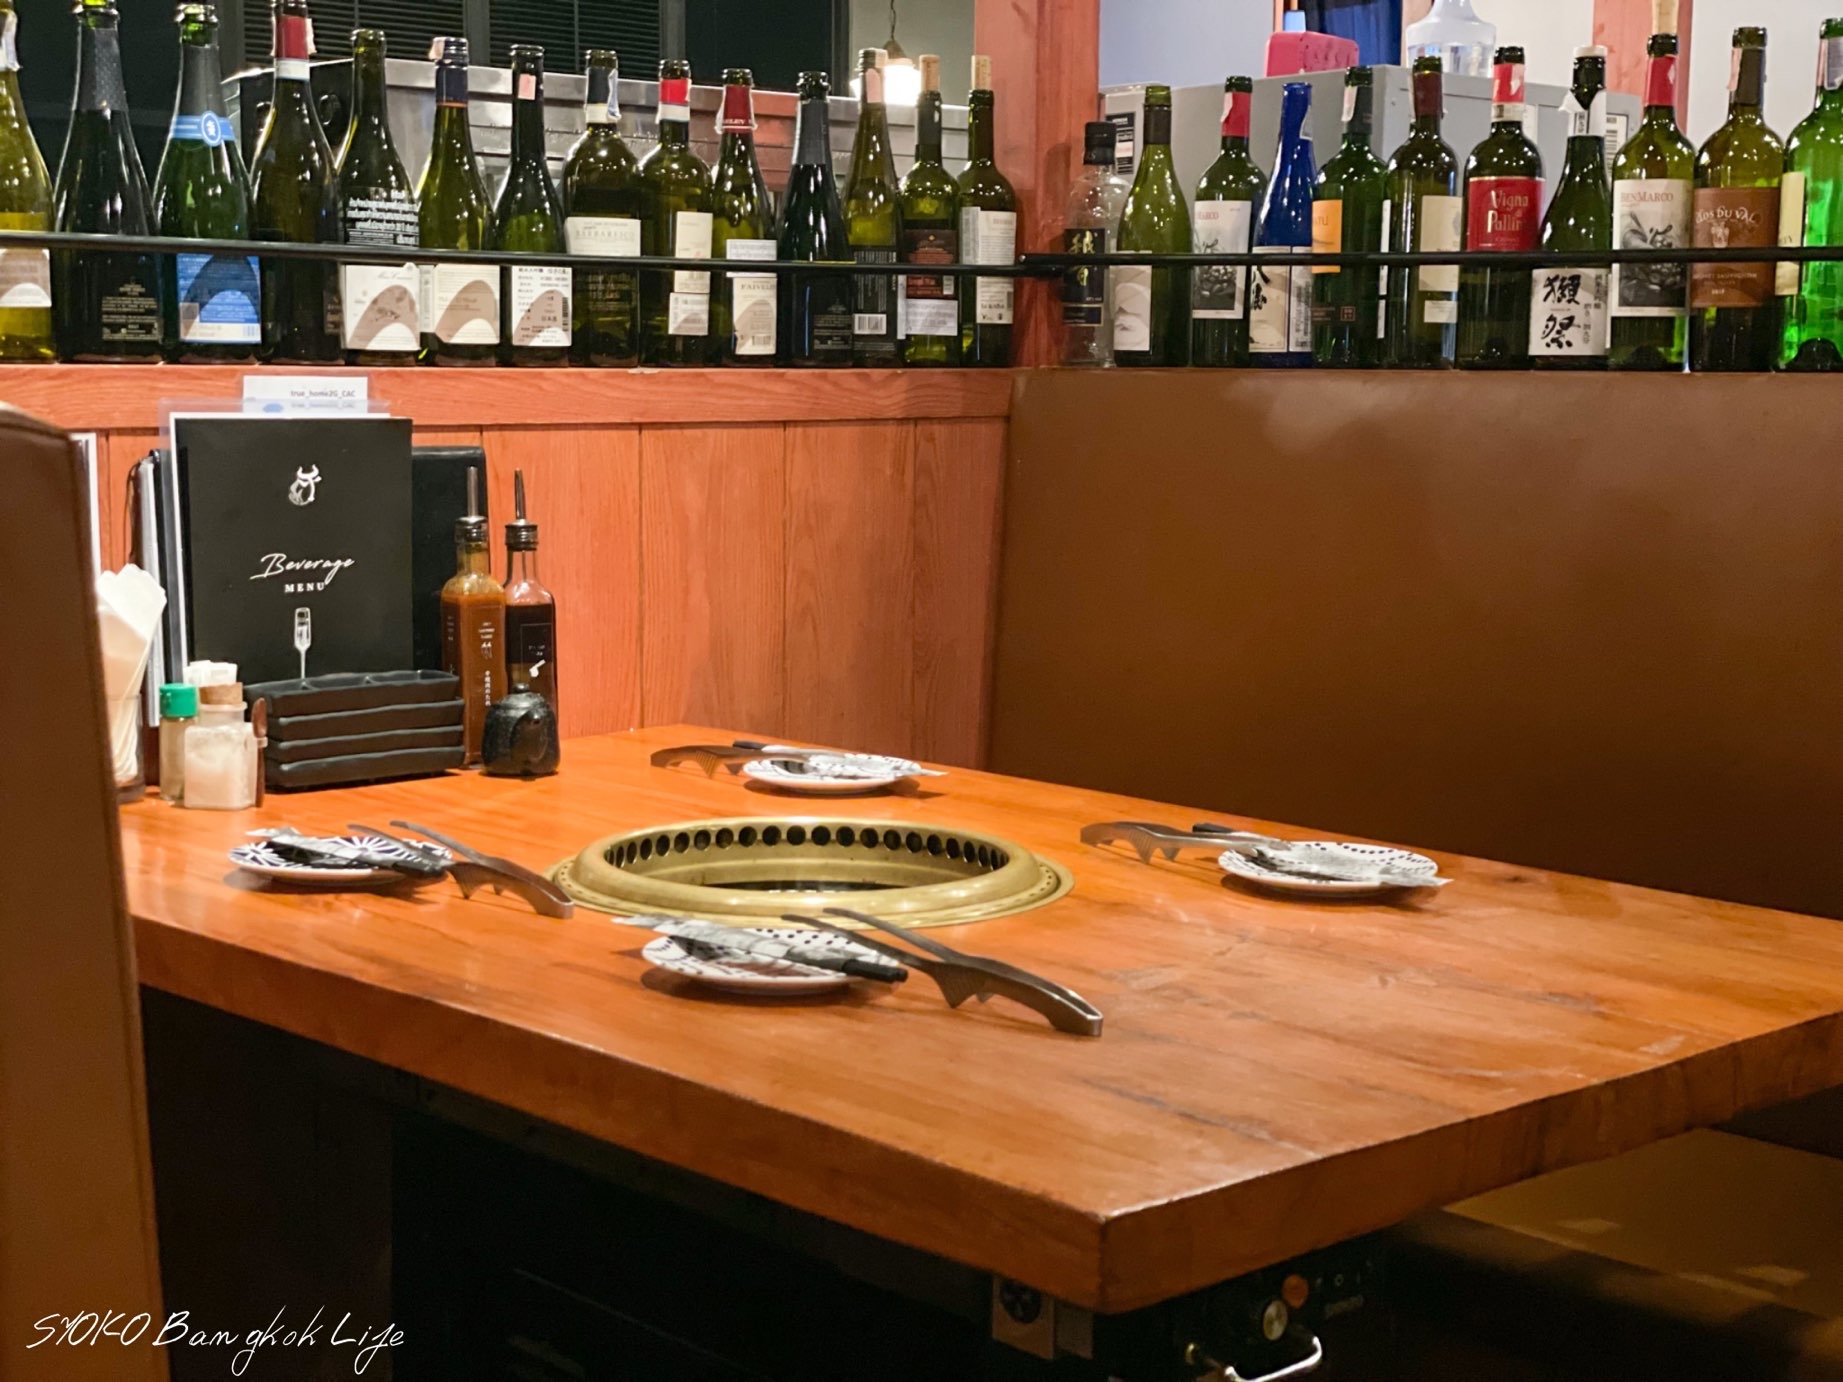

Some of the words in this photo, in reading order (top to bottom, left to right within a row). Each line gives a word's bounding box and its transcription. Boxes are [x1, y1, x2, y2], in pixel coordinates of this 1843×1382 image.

[1491, 190, 1529, 211] Vigna
[249, 552, 356, 586] Beverage
[284, 581, 326, 594] MENU
